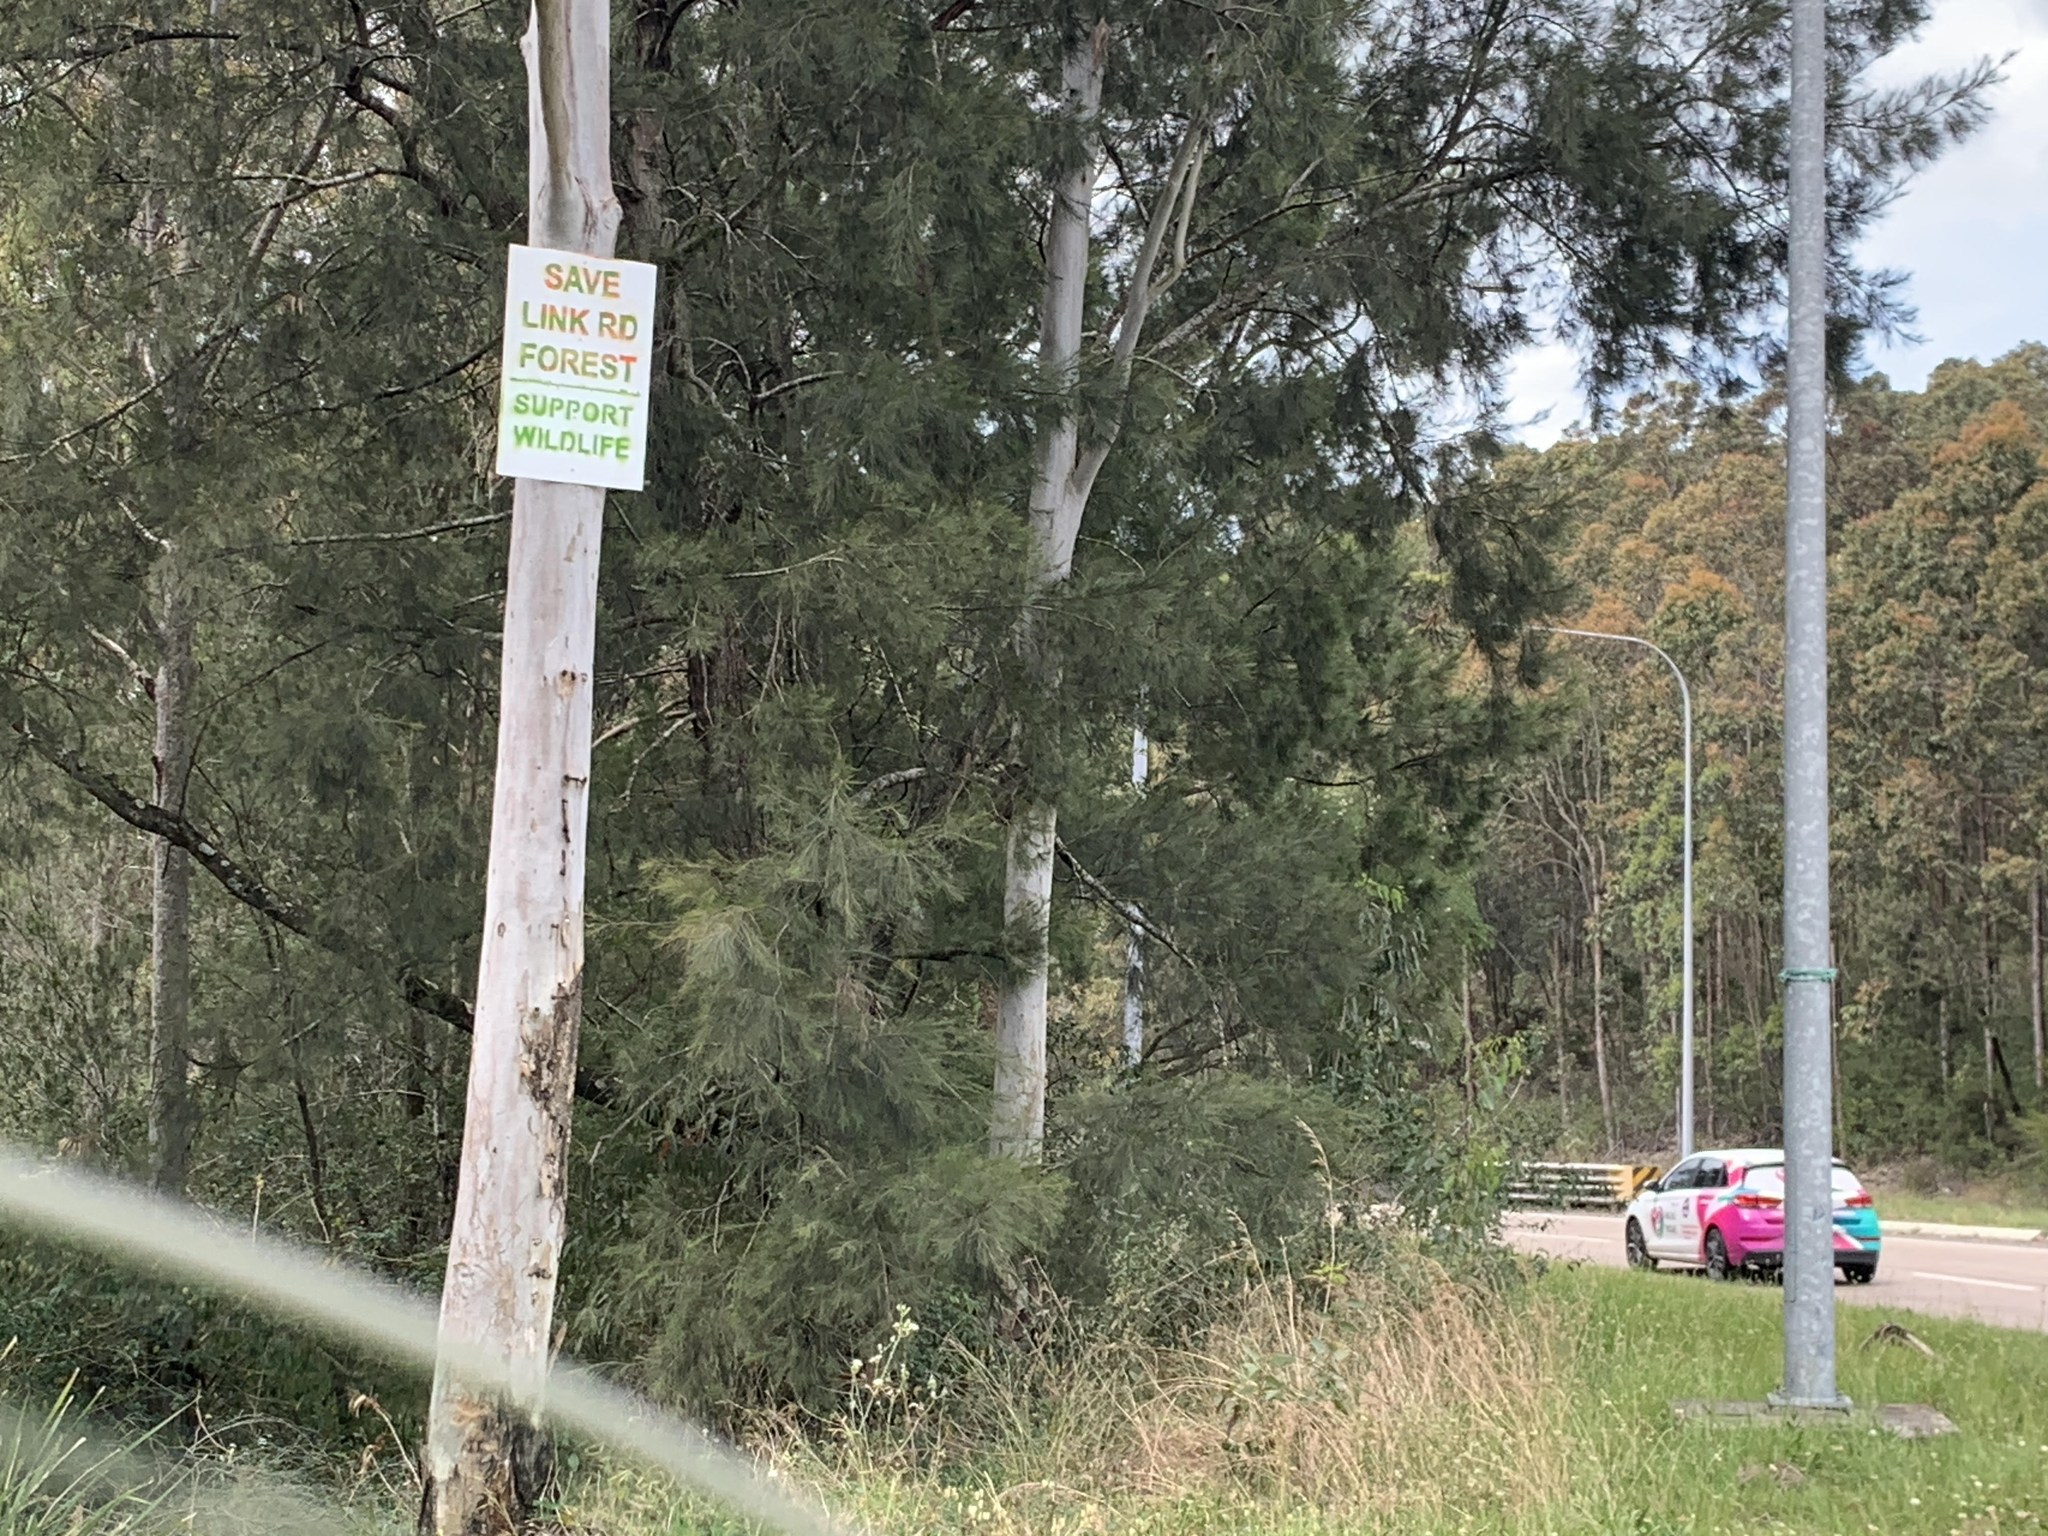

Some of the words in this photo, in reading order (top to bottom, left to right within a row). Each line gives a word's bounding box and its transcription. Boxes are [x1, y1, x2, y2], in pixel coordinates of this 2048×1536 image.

[544, 263, 621, 299] SAVE
[522, 301, 589, 336] LINK
[598, 311, 639, 341] RD
[519, 342, 638, 383] FOREST
[513, 393, 634, 427] SUPPORT
[514, 425, 630, 459] WILDLIFE
